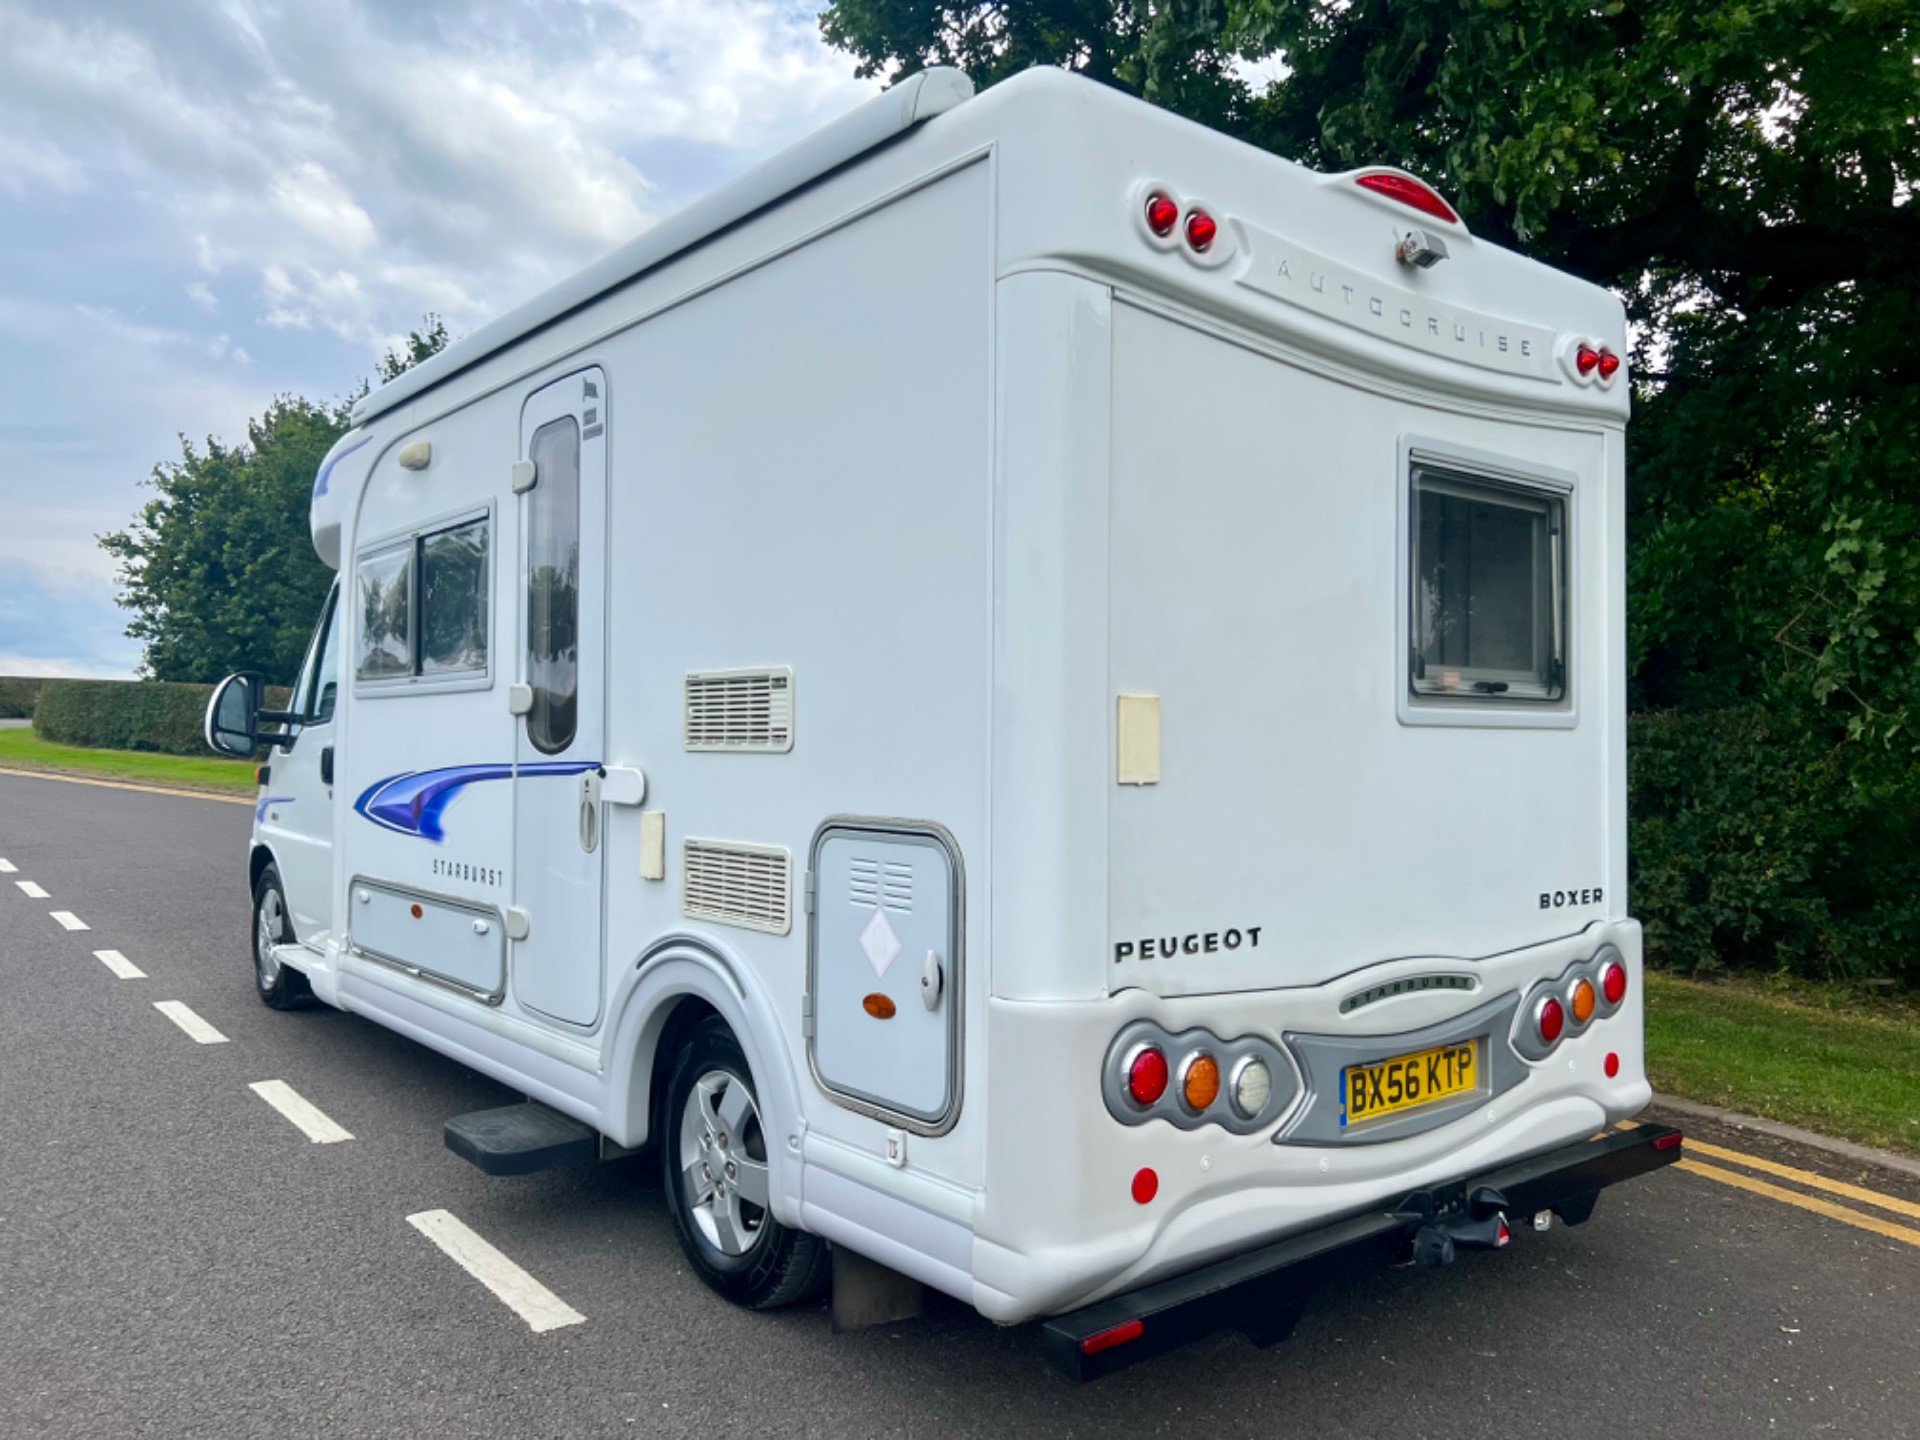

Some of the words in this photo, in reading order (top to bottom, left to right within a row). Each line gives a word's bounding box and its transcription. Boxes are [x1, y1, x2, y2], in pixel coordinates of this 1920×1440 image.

[1278, 260, 1531, 356] AUTOCRUISE
[433, 858, 503, 887] STARBURST
[1539, 887, 1603, 909] BOXER
[1114, 927, 1262, 964] PEUGEOT
[1351, 1061, 1420, 1114] BX56
[1427, 1048, 1472, 1094] KTP
